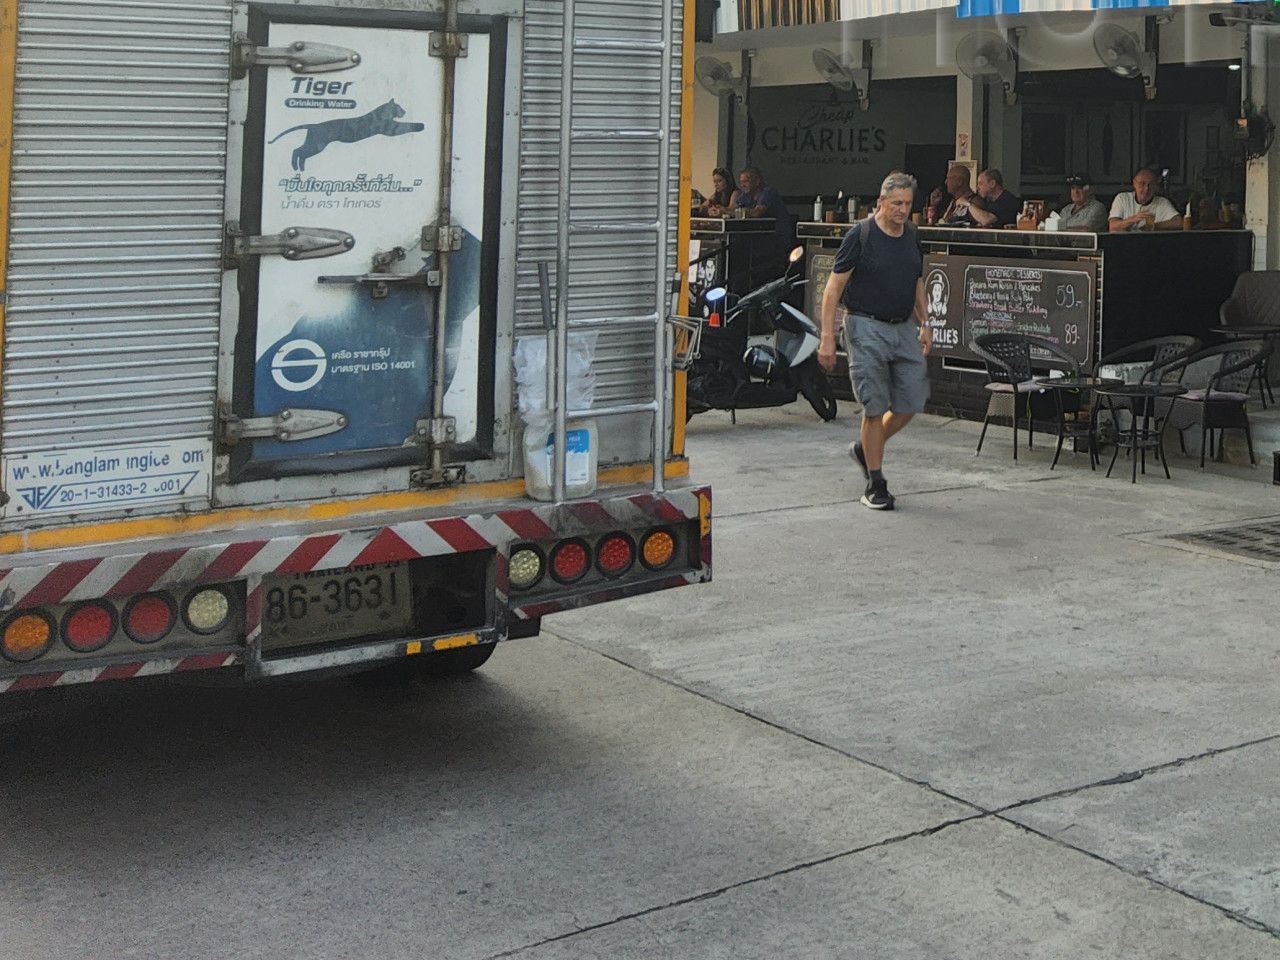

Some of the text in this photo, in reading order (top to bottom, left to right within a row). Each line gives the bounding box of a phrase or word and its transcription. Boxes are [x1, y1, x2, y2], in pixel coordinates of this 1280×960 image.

[291, 76, 354, 96] Tiger
[288, 98, 353, 109] Drinking Water
[761, 125, 887, 152] CHARLIE'S
[317, 200, 340, 209] ตรา
[371, 362, 388, 371] ISO
[390, 360, 416, 370] 14001
[265, 571, 397, 624] 86-3631
